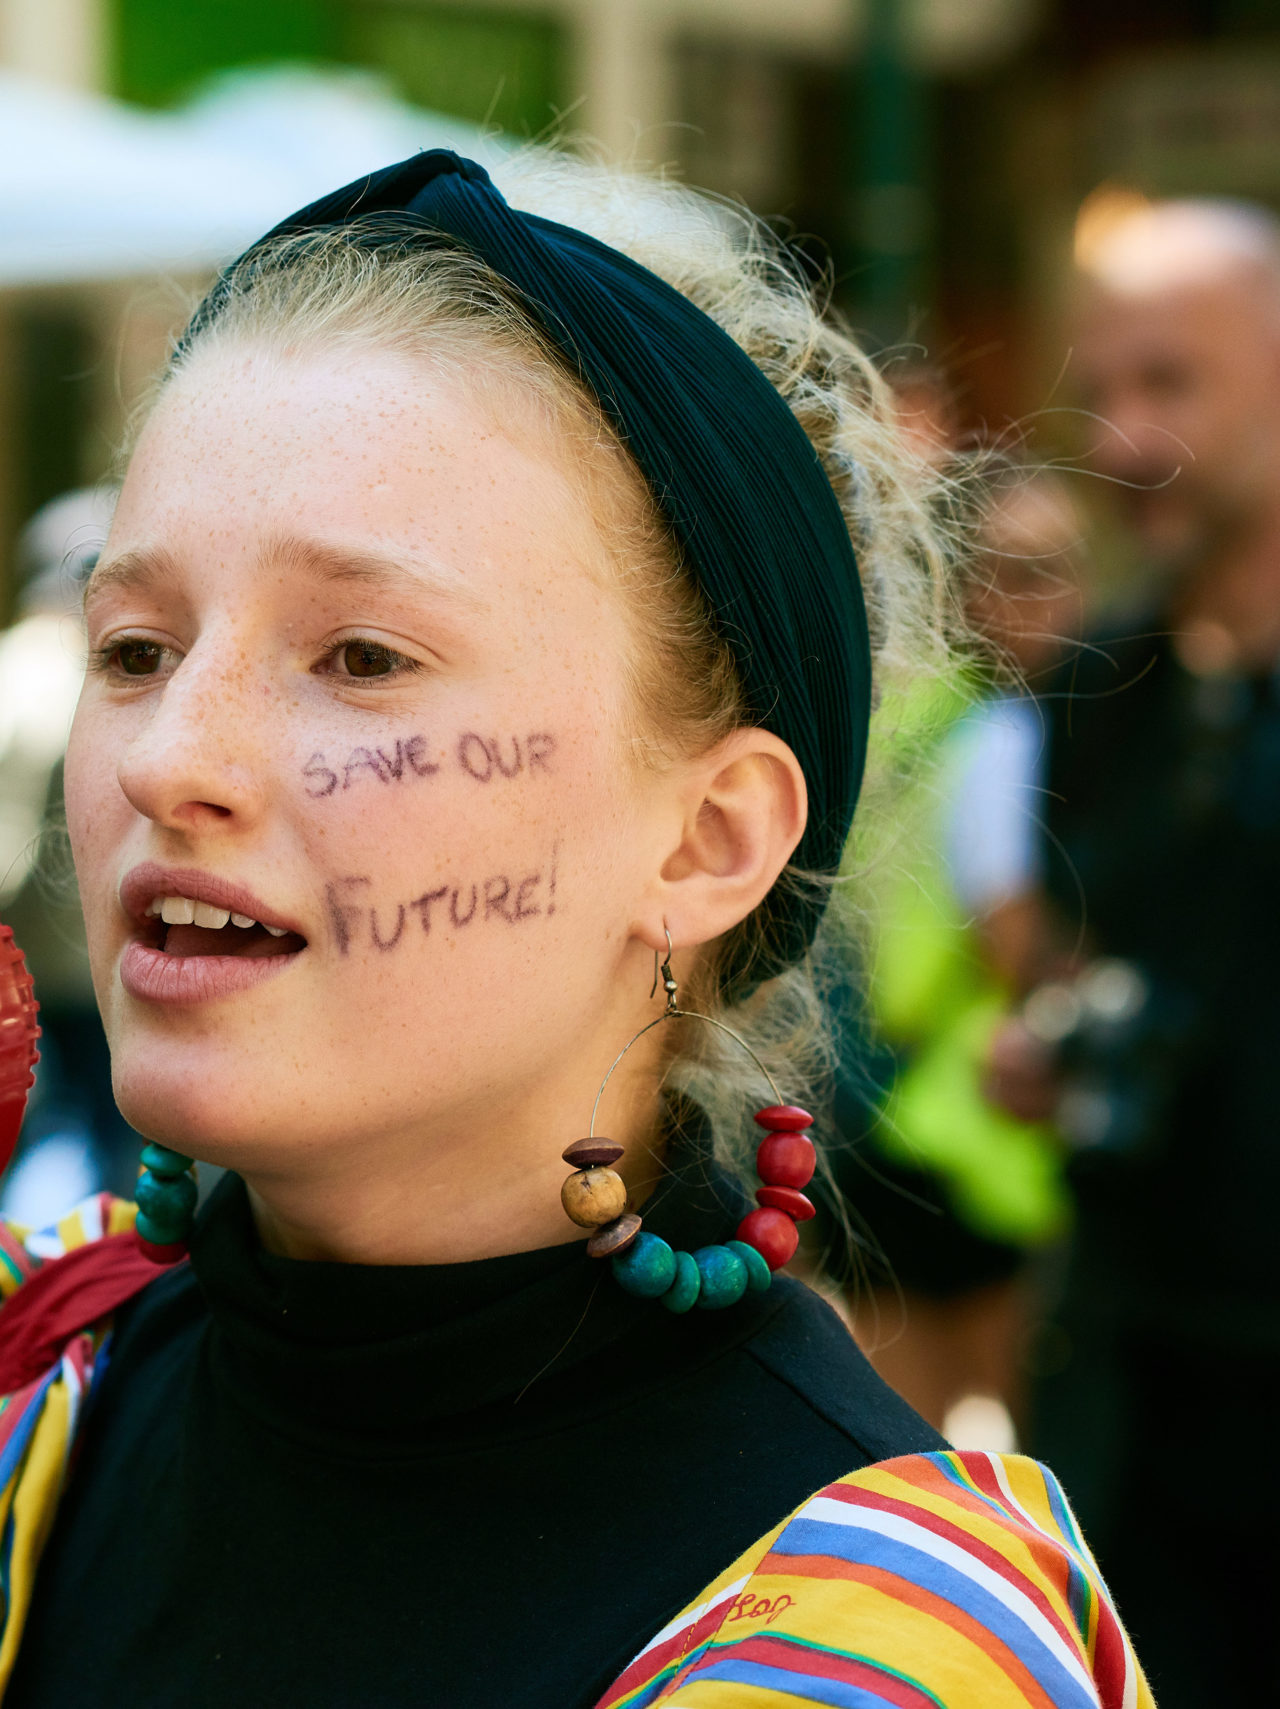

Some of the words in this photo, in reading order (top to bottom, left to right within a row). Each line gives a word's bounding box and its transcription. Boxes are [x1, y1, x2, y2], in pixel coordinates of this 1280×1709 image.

[302, 734, 439, 798] SAVE
[457, 731, 557, 783] OUR
[323, 838, 559, 958] FUTURE!
